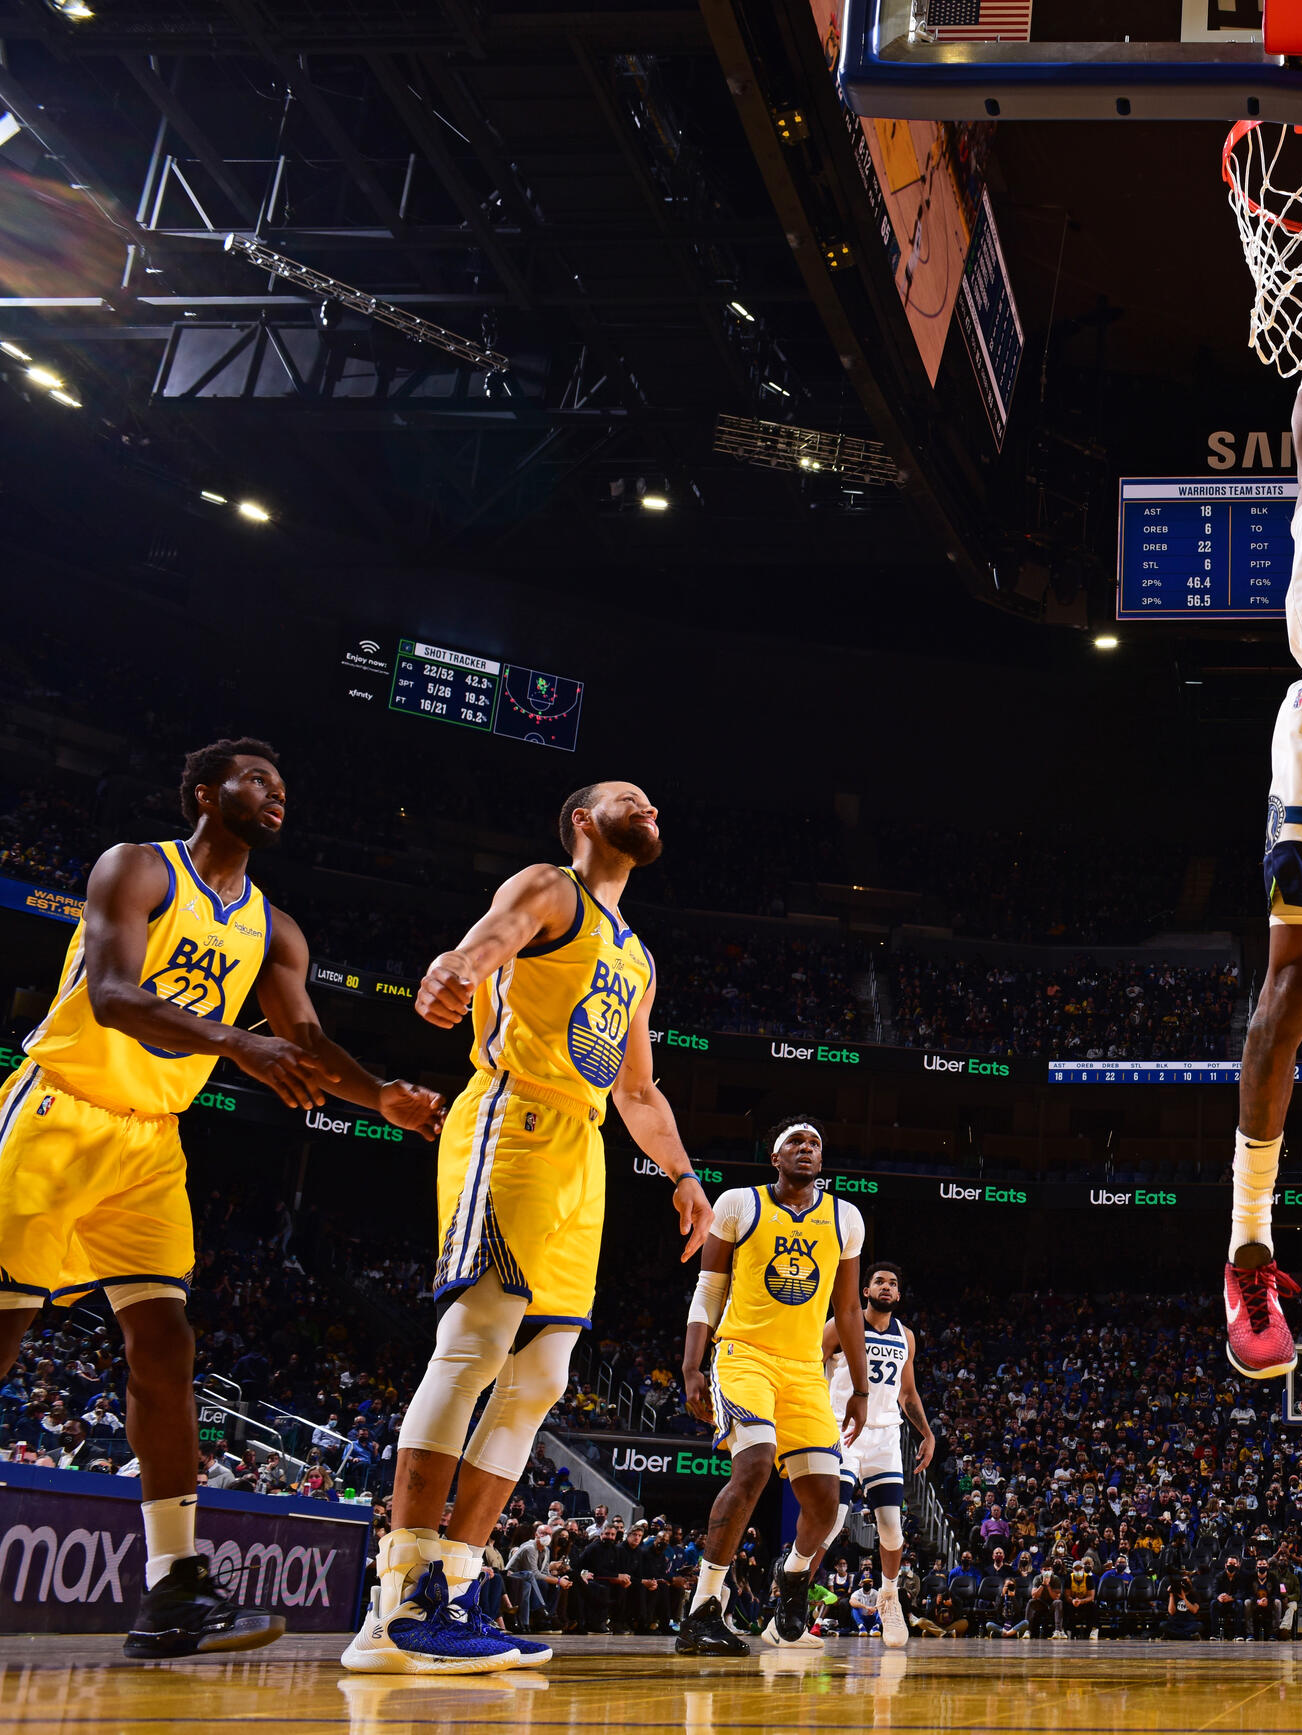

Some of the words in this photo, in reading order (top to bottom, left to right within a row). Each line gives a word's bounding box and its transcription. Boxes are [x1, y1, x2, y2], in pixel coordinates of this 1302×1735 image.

[1178, 486, 1226, 496] WARRIORS
[1229, 486, 1253, 496] TEAM
[1255, 485, 1284, 495] STATS
[1144, 508, 1162, 516] AST
[1200, 505, 1212, 517] 18
[1250, 507, 1268, 515] BLK
[1143, 526, 1169, 534] OREB
[1204, 523, 1212, 535] 6
[1198, 541, 1212, 553] 22
[1204, 559, 1211, 570] 6
[1142, 579, 1162, 587] 2P%
[1187, 577, 1211, 589] 46.4
[1250, 579, 1272, 587] FG%
[1142, 597, 1162, 605] 3P%
[1187, 595, 1211, 607] 56.5
[1250, 597, 1270, 605] FT%
[346, 652, 368, 665] Enjoy
[424, 647, 449, 660] SHOT
[449, 652, 487, 670] TRACKER
[401, 661, 413, 670] FG
[423, 664, 455, 681] 22/52
[349, 688, 373, 701] xfinity
[398, 678, 414, 688] 3PT
[427, 682, 452, 698] 5/26
[395, 696, 407, 704] FT
[420, 698, 447, 715] 16/21
[34, 889, 87, 908] WARRIO
[234, 921, 263, 938] Rakuten
[204, 934, 224, 948] The
[167, 937, 240, 984] BAY
[318, 968, 343, 983] LATECH
[346, 975, 360, 989] 80
[376, 983, 413, 998] FINAL
[590, 958, 636, 1009] BAY
[166, 976, 208, 1016] 22
[596, 998, 622, 1041] 30
[649, 1030, 664, 1043] er
[667, 1030, 709, 1050] Eats
[772, 1042, 813, 1060] Uber
[817, 1046, 859, 1064] Eats
[923, 1055, 965, 1073] Uber
[968, 1058, 1010, 1077] Eats
[1055, 1072, 1063, 1081] 18
[1082, 1072, 1087, 1081] 6
[1105, 1072, 1116, 1081] 22
[1133, 1072, 1139, 1081] 6
[1159, 1072, 1165, 1081] 2
[1183, 1072, 1192, 1081] 10
[1210, 1072, 1217, 1081] 11
[306, 1110, 352, 1136] Uber
[354, 1118, 403, 1142] Eats
[815, 1177, 832, 1190] er
[835, 1176, 879, 1193] Eats
[940, 1183, 982, 1201] Uber
[985, 1186, 1027, 1204] Eats
[1090, 1189, 1131, 1205] Uber
[1135, 1189, 1177, 1206] Eats
[774, 1236, 818, 1257] BAY
[789, 1257, 800, 1276] 5
[868, 1360, 898, 1386] 32
[611, 1446, 672, 1474] Uber
[676, 1452, 732, 1478] Eats
